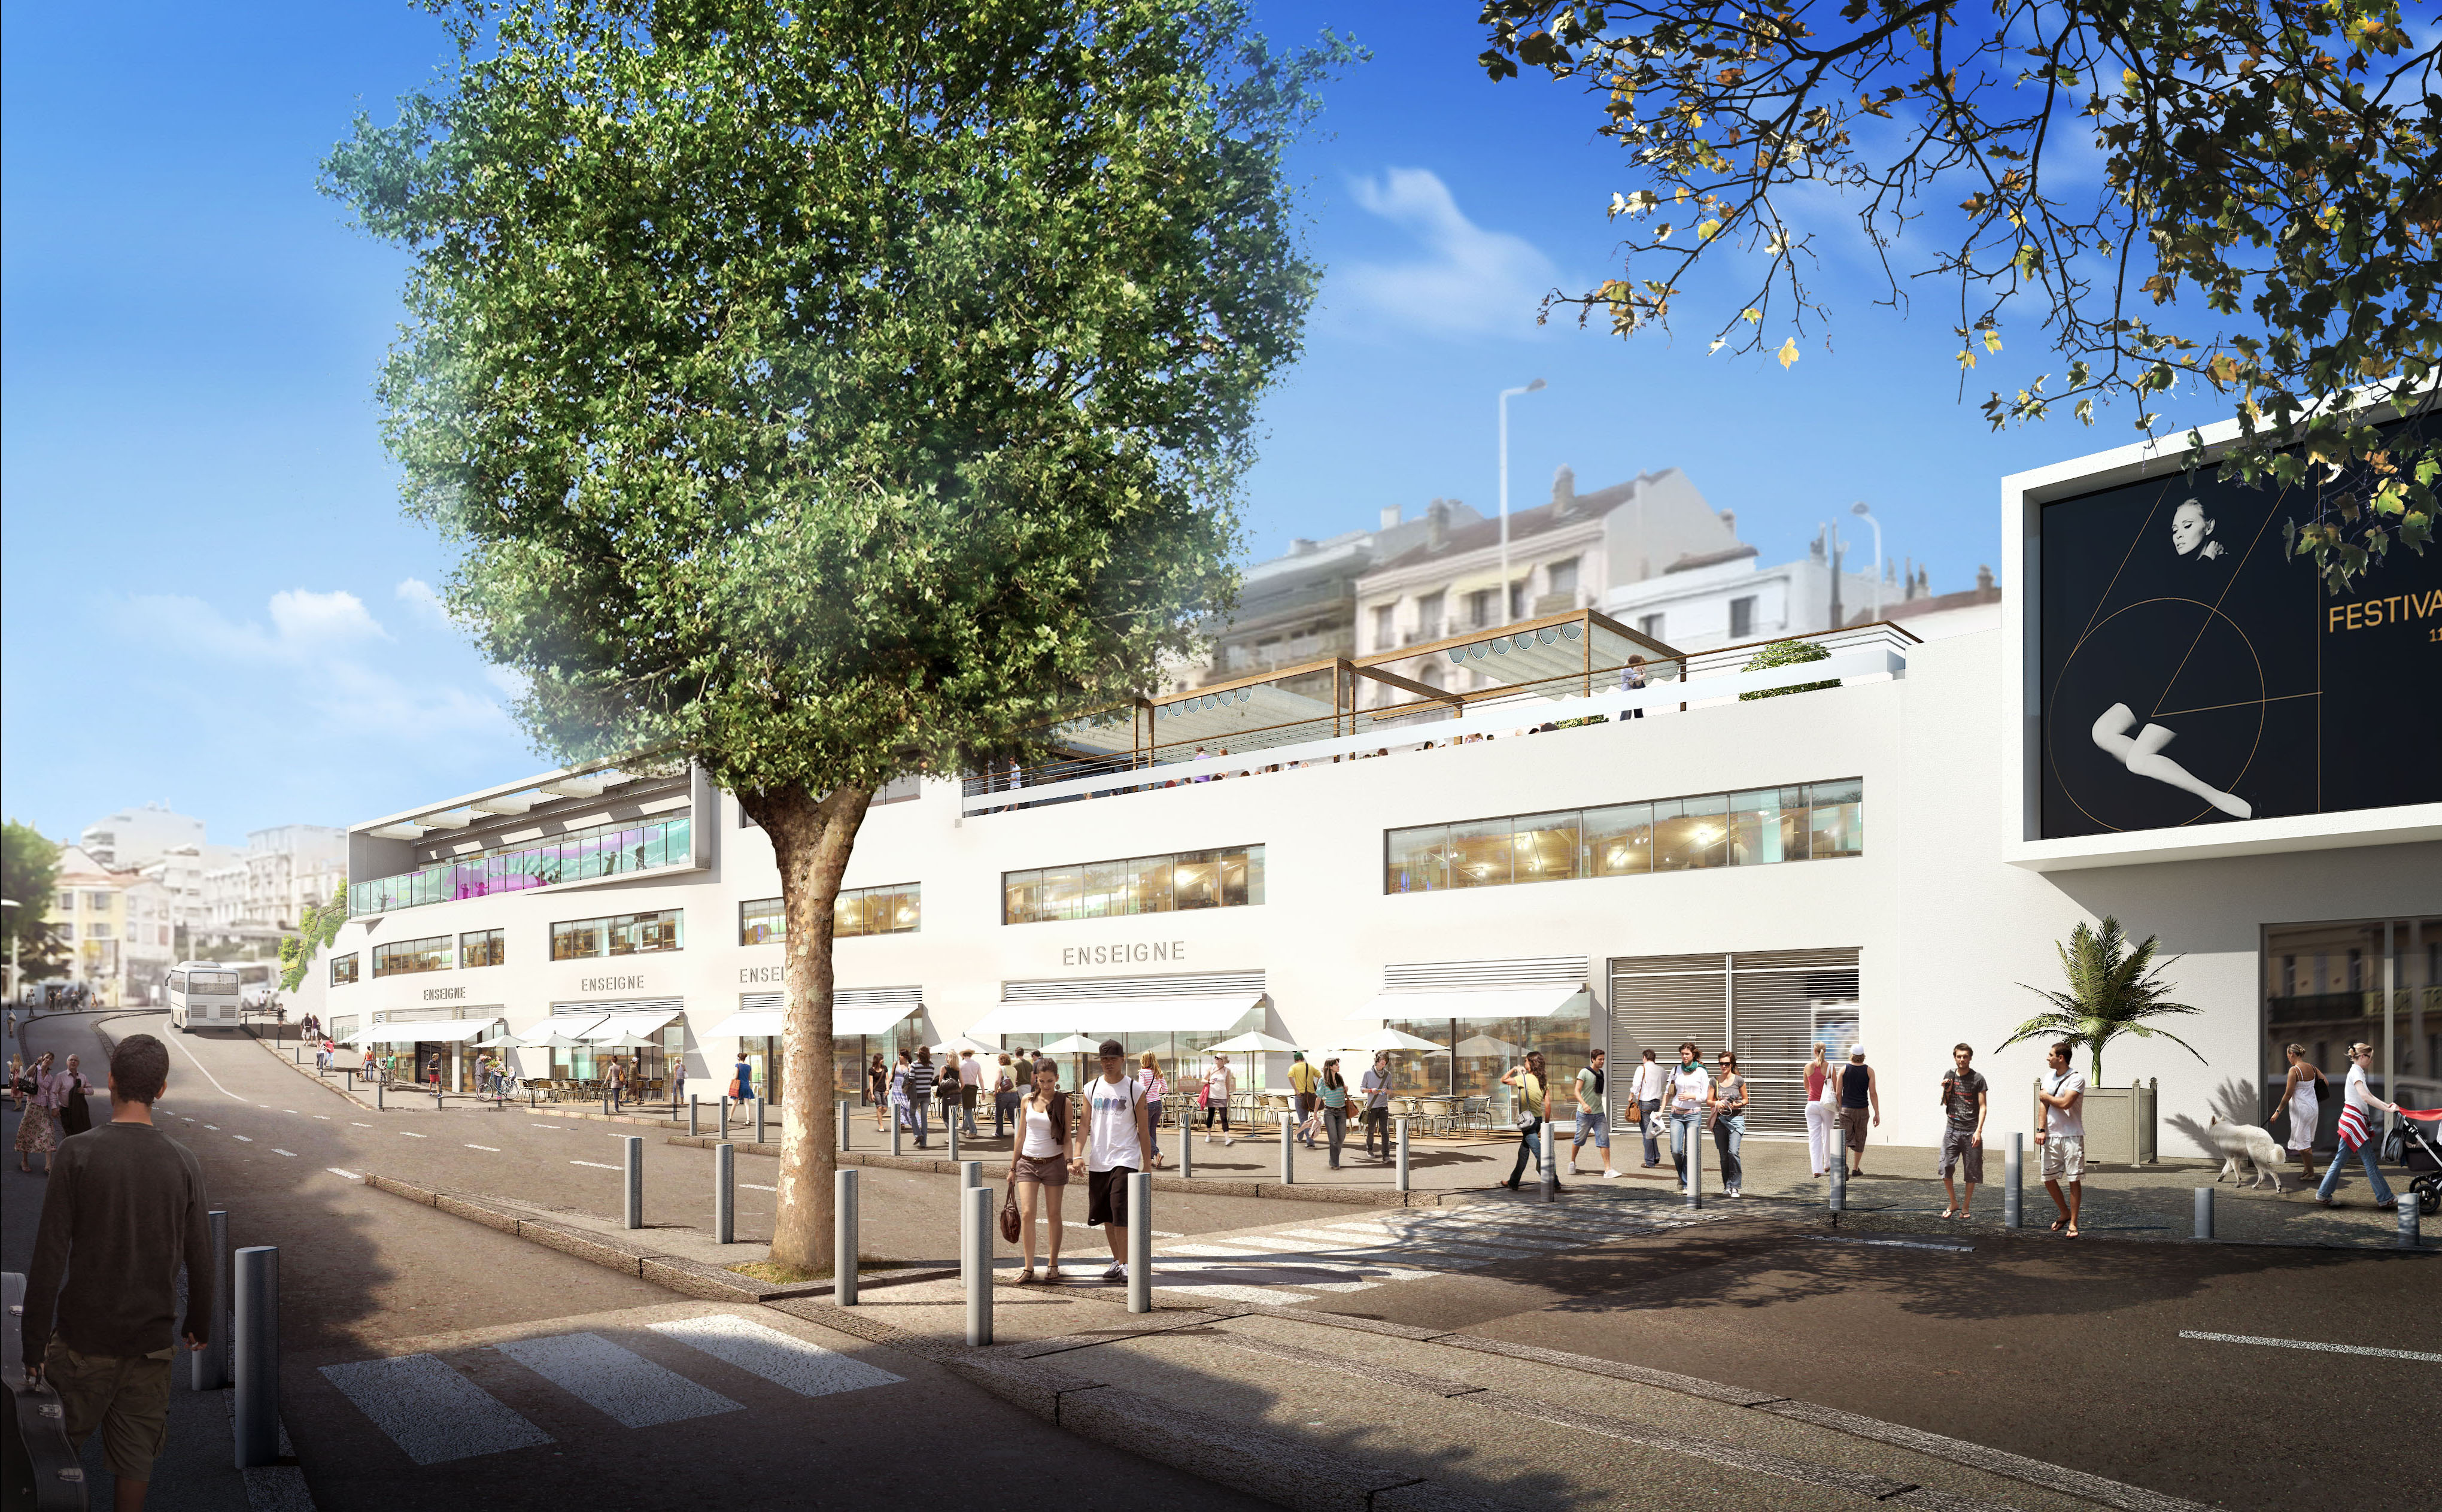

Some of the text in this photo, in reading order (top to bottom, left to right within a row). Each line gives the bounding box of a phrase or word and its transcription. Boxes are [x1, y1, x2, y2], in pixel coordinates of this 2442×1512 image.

[2329, 589, 2442, 633] FESTIVA
[1063, 940, 1184, 966] ENSEIGNE
[423, 986, 466, 1001] ENSEIGNE
[581, 974, 644, 992] ENSEIGNE
